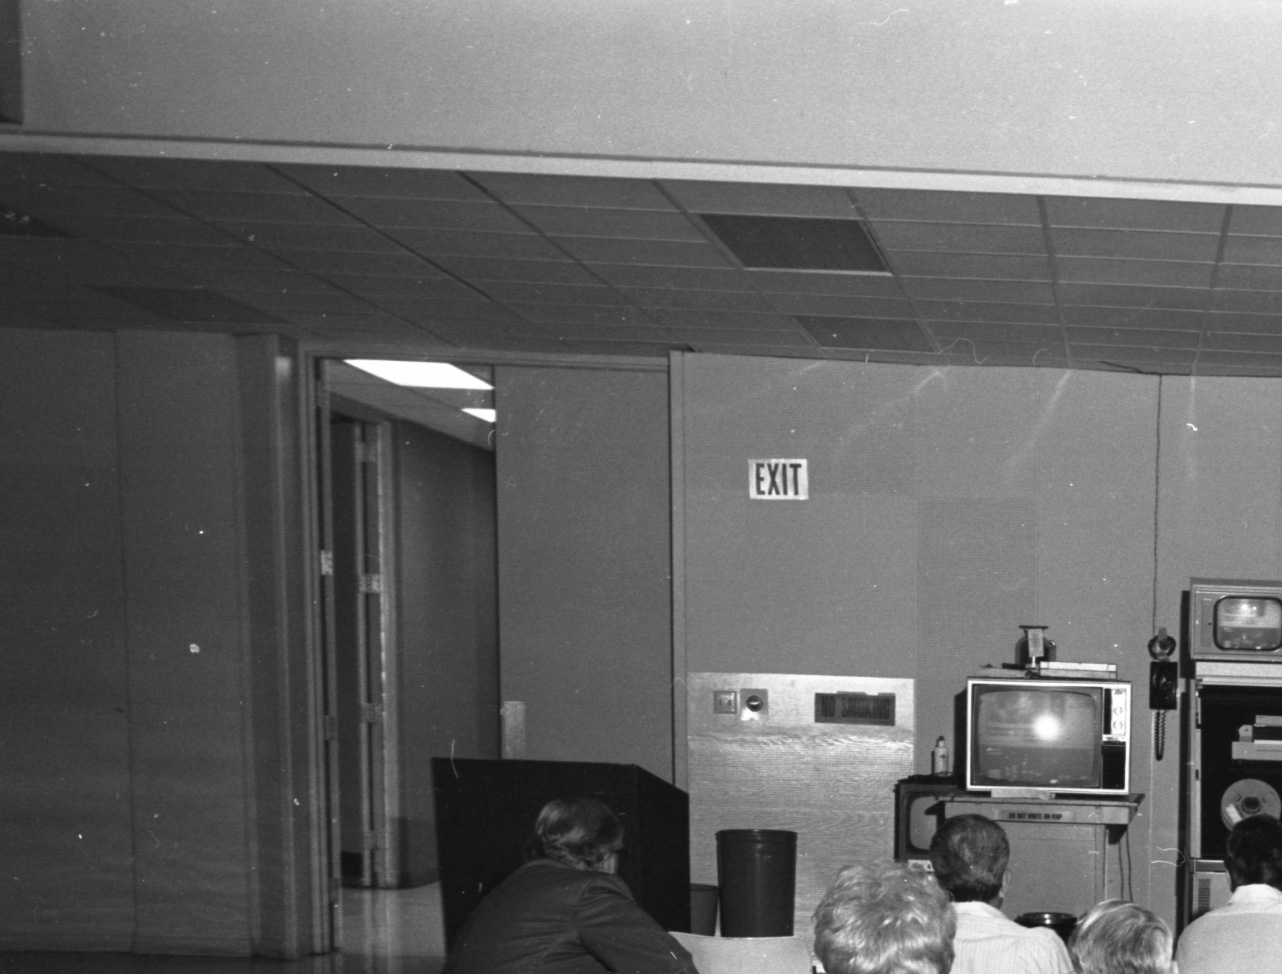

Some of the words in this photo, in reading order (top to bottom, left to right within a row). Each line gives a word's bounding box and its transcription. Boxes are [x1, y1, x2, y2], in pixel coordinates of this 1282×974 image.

[755, 462, 802, 495] EXIT
[821, 695, 836, 718] NO
[841, 696, 891, 720] SMOKING
